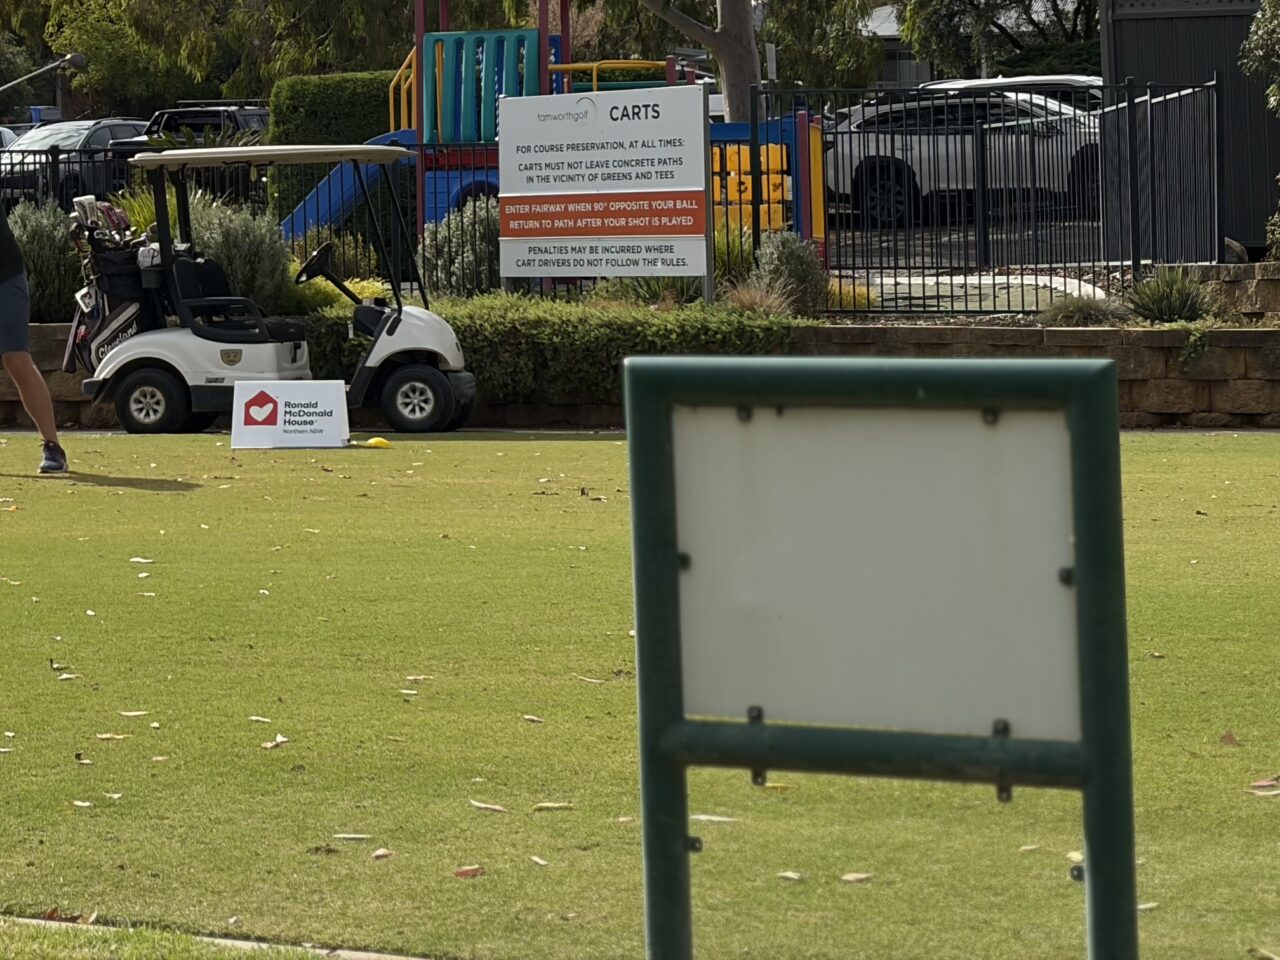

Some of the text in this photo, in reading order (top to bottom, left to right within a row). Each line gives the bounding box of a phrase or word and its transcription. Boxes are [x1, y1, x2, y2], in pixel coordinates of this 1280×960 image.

[609, 103, 661, 121] CARTS
[516, 138, 686, 154] FOR COURSE PRESERVATION, AT ALL TIMES:
[518, 157, 683, 172] CARTS MUST NOT LEAVE CONCRETE PATHS
[526, 170, 675, 184] IN THE VICINITY OF GREENS AND TEES
[505, 205, 530, 214] ENTER
[531, 203, 565, 213] FAIRWAY
[567, 202, 592, 212] WHEN
[609, 201, 650, 211] OPPOSITE
[651, 200, 674, 210] YOUR
[675, 200, 698, 209] BALL
[509, 216, 694, 229] RETURN TO PATH AFTER YOUR SHOT IS PLAYED
[528, 245, 675, 255] PENALTIES MAY BE INCURRED WHERE
[516, 258, 689, 268] CART DRIVERS DO NOT FOLLOW THE RULES.
[284, 401, 318, 409] Ronald
